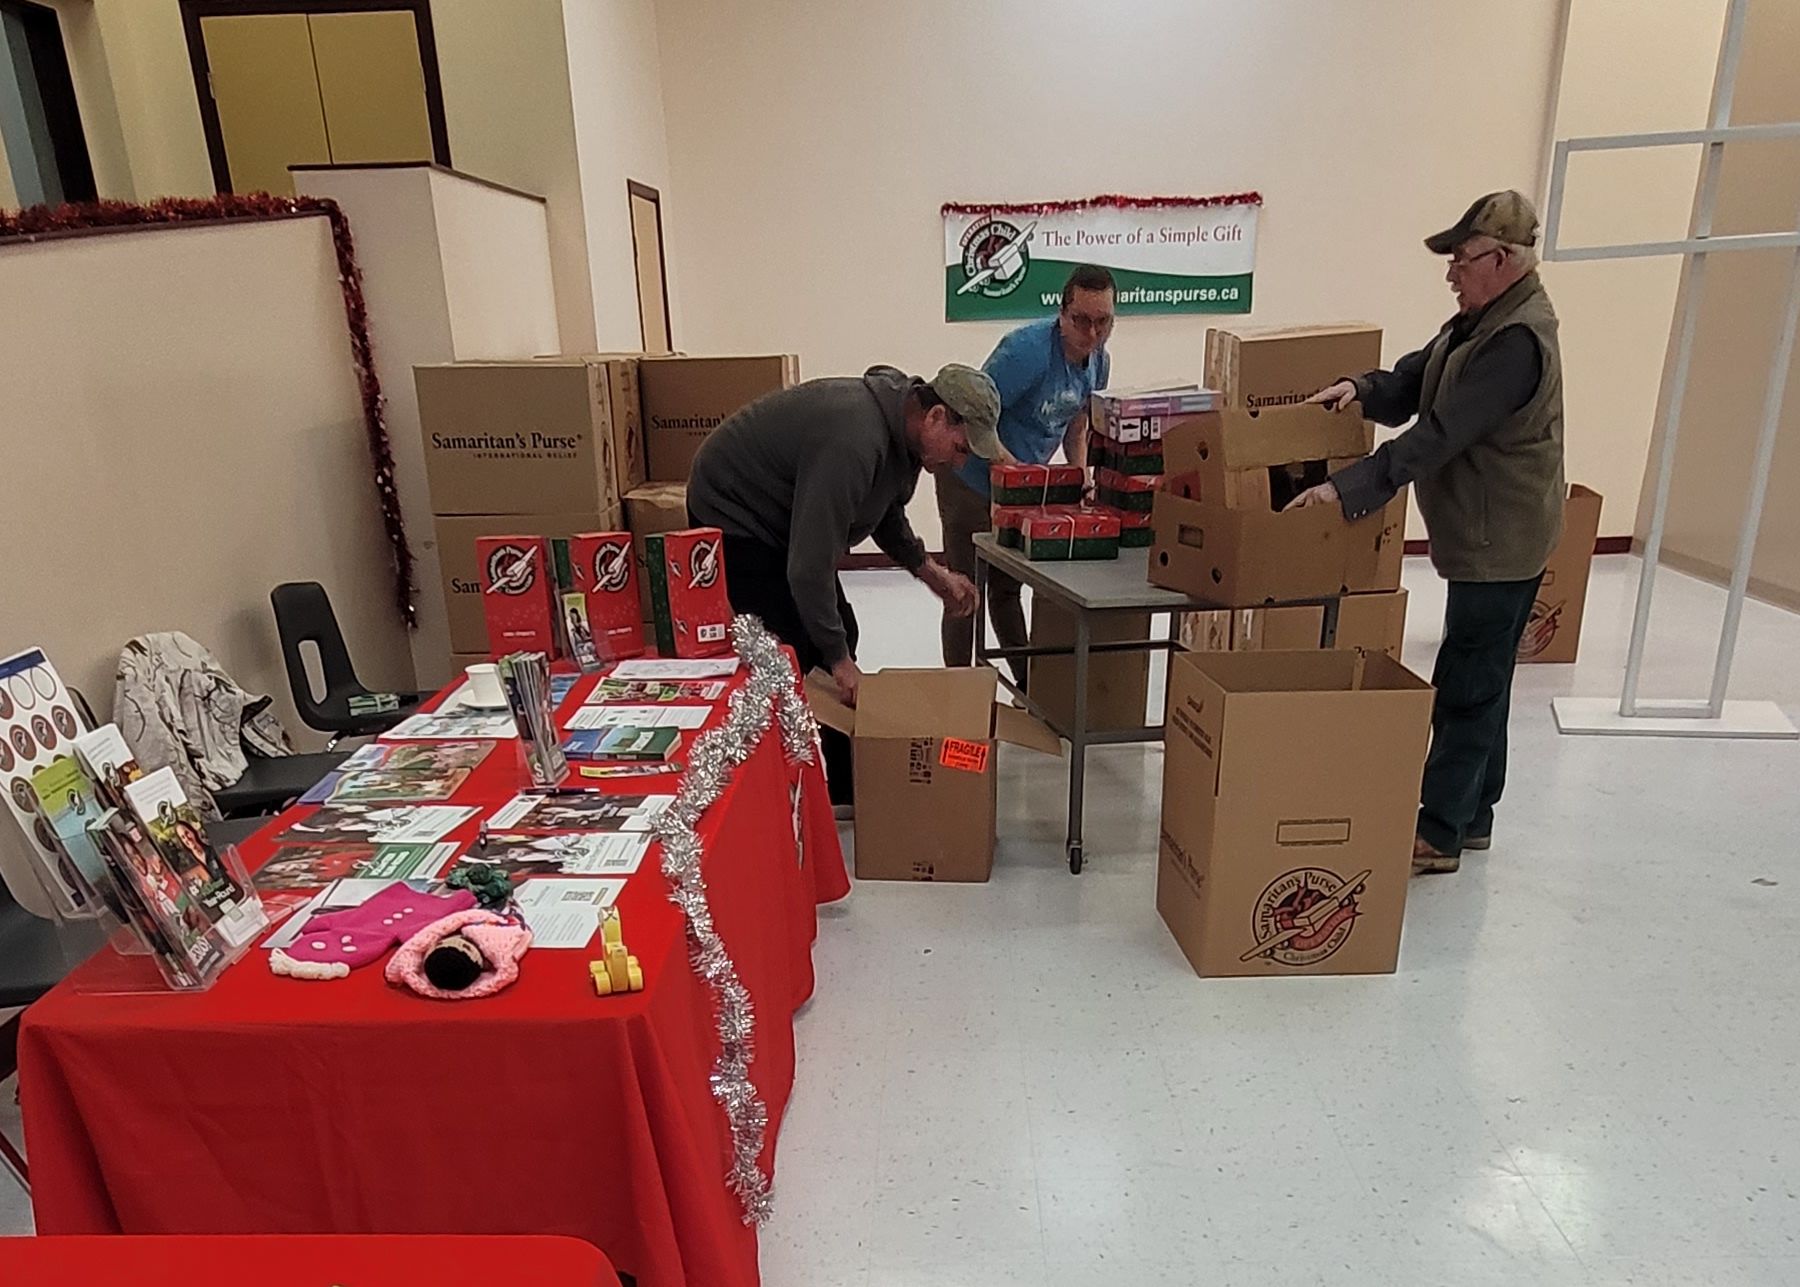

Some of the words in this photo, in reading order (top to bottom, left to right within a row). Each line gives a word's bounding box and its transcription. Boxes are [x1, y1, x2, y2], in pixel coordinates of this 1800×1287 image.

[1042, 230, 1071, 247] The
[1076, 229, 1122, 246] Power
[1126, 227, 1143, 245] of
[1146, 232, 1155, 244] a
[1159, 225, 1209, 247] Simple
[1213, 223, 1243, 242] Gift
[1142, 420, 1150, 437] 8
[432, 432, 527, 449] Samaritan's
[531, 432, 577, 449] Purse
[949, 740, 982, 758] FRAGILE
[1304, 871, 1337, 893] Purse
